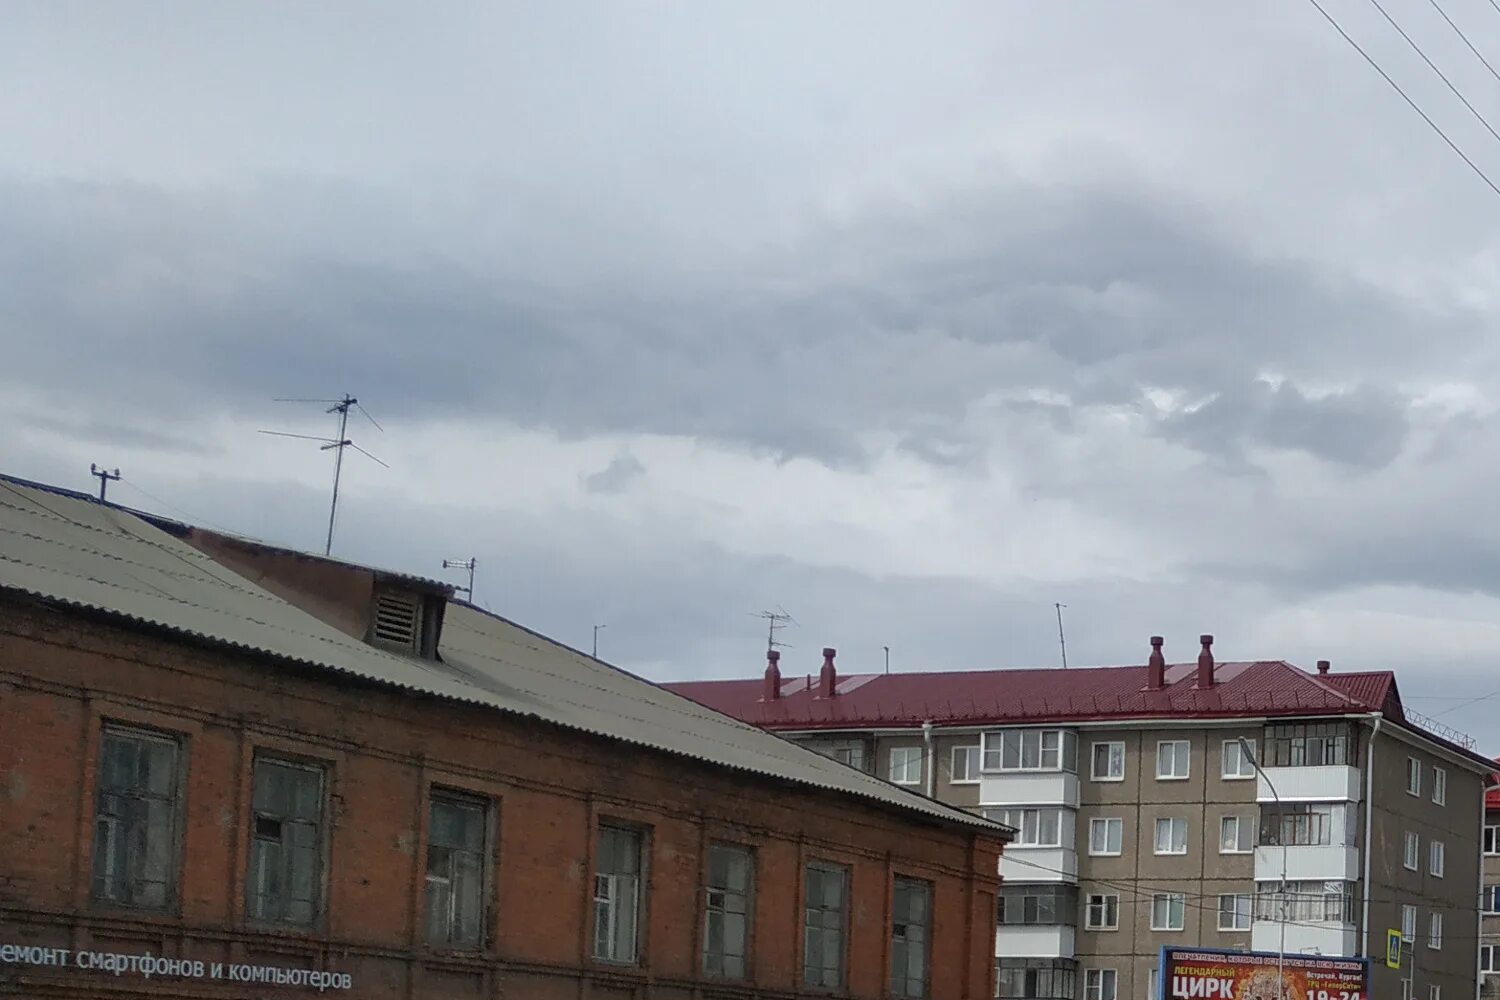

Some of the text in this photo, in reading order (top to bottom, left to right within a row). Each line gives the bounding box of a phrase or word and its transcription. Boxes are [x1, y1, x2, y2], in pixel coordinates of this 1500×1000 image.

[0, 944, 352, 992] емонт смартфонов и компьютеров
[1264, 957, 1304, 967] ОСТНУТСЯ
[1174, 966, 1235, 977] ЛЕГЕНДАРНЫЙ
[1172, 976, 1234, 999] ЦИРК
